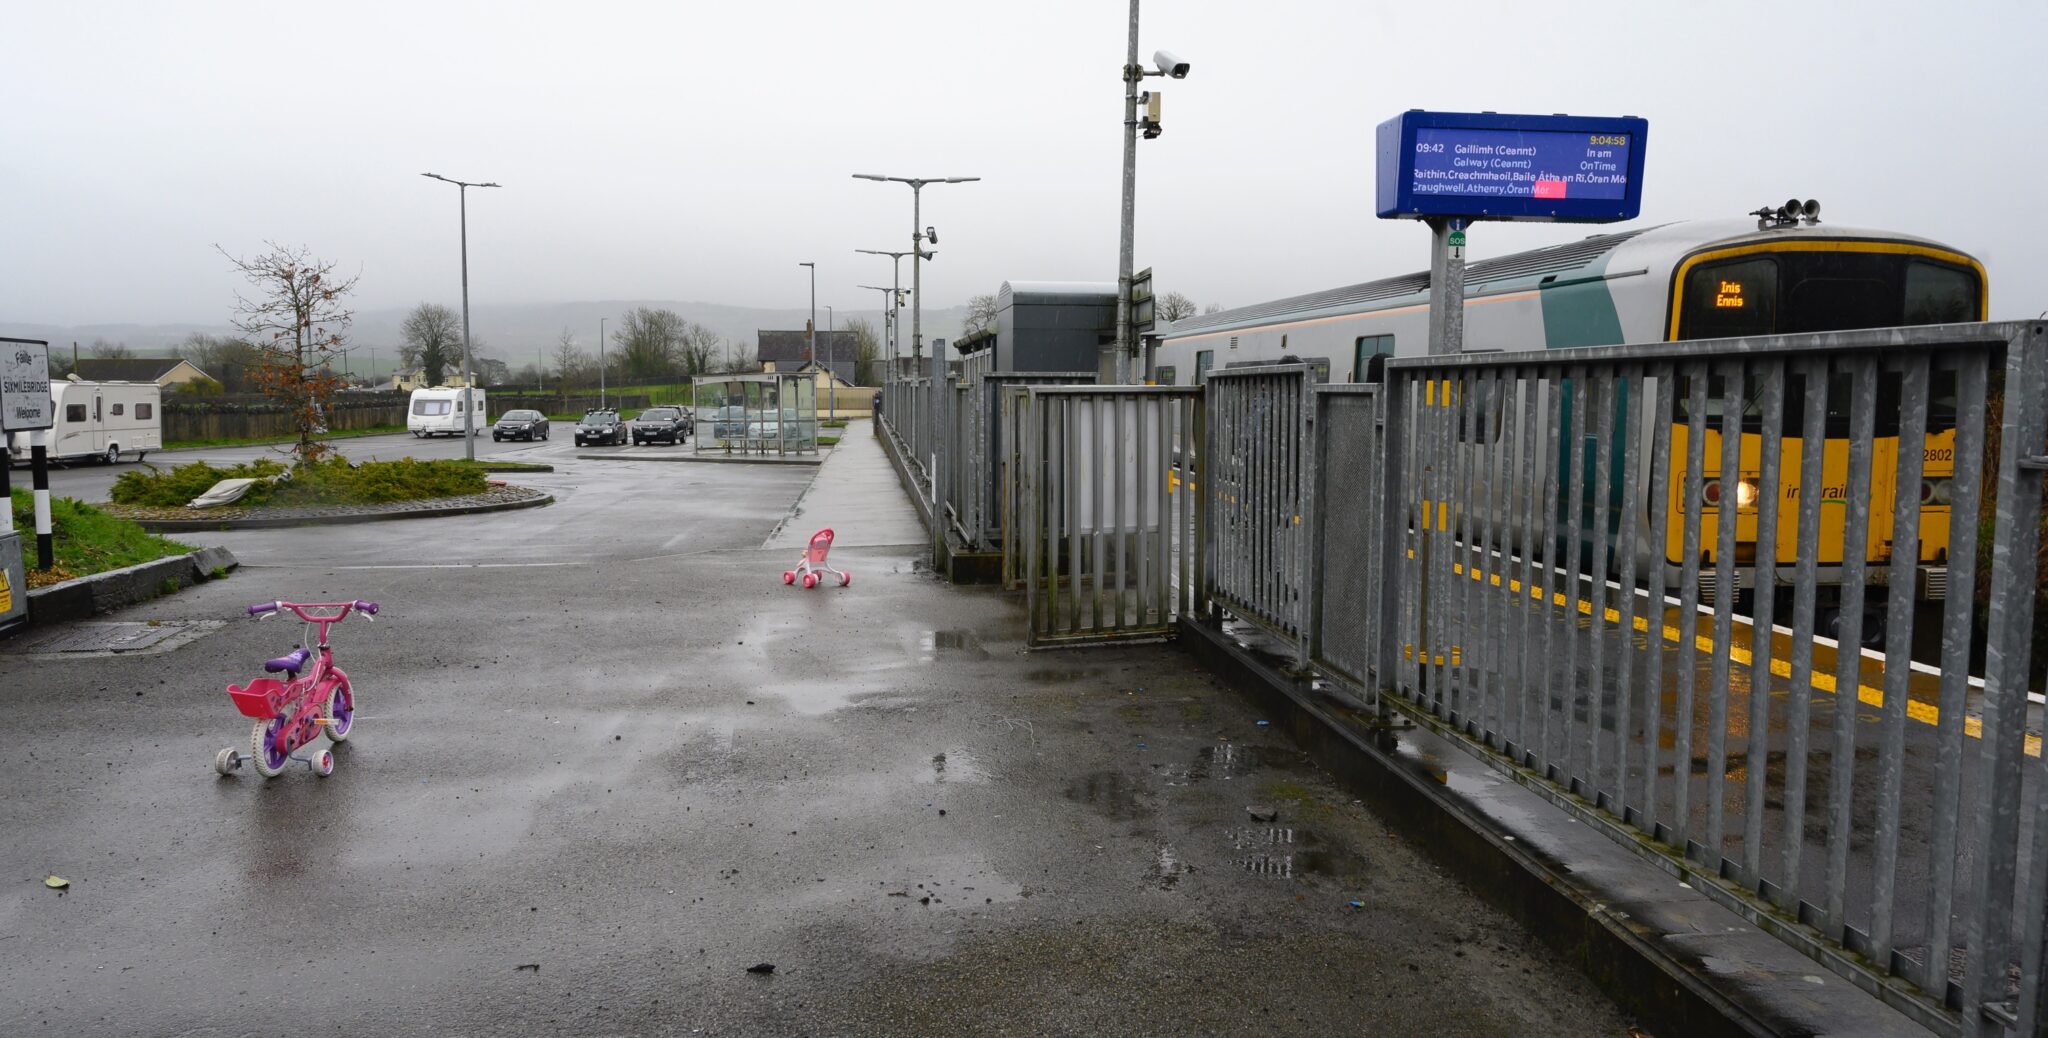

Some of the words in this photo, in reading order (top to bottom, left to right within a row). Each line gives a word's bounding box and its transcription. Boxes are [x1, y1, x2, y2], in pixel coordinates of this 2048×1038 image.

[1590, 136, 1626, 146] 9:04:58
[1416, 143, 1444, 153] 09:42
[1454, 144, 1493, 155] Gaillimh
[1495, 145, 1536, 156] (Ceannt)
[1586, 148, 1596, 158] In
[1597, 150, 1612, 158] am
[1453, 157, 1489, 169] Galway
[1490, 158, 1532, 169] (Ceannt)
[1562, 175, 1574, 183] an
[1450, 237, 1465, 245] SOS
[1721, 281, 1741, 294] Inis
[1716, 294, 1743, 307] Ennis
[4, 381, 48, 393] SIXMILEBRIDGE
[1923, 448, 1952, 462] 2802
